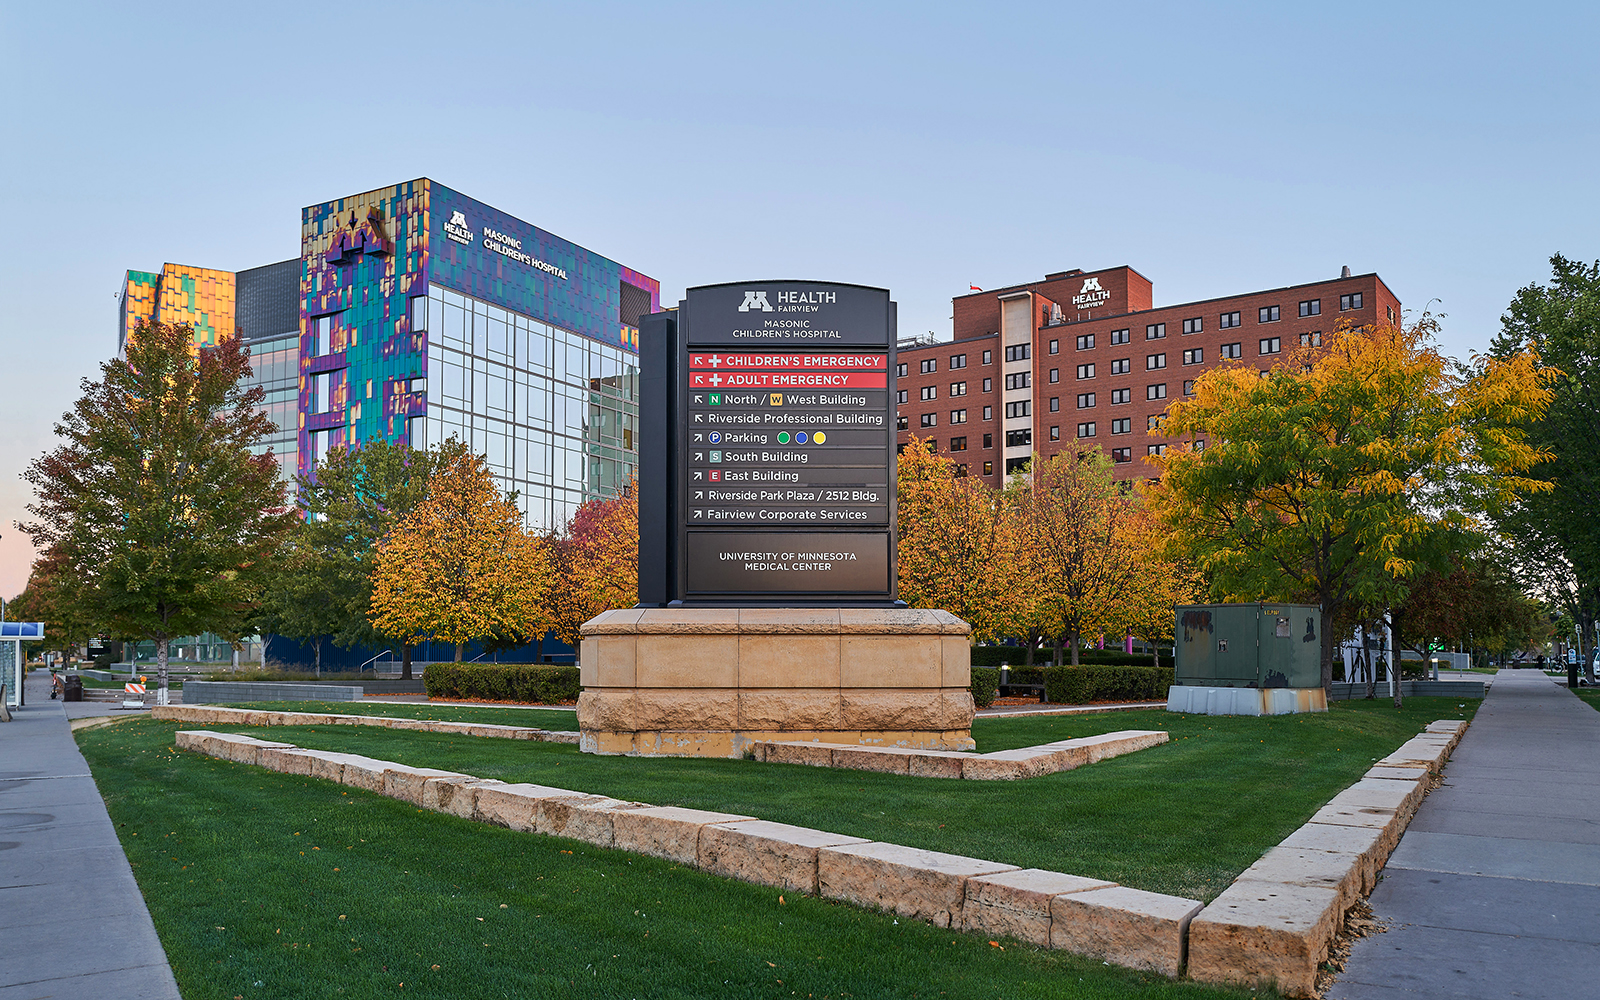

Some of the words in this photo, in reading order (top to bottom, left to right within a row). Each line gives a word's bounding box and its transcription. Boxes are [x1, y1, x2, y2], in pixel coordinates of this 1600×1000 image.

[444, 222, 473, 242] HEALTH
[484, 227, 522, 250] MASONIC
[484, 239, 531, 265] CHILDREN'S
[532, 258, 568, 280] HOSPITAL
[778, 292, 836, 303] HEALTH
[1072, 290, 1110, 304] HEALTH
[764, 320, 810, 328] MASONIC
[732, 330, 790, 338] CHILDREN'S
[794, 330, 842, 338] HOSPITAL
[726, 356, 800, 366] CHILDREN'S
[804, 356, 880, 366] EMERGENCY
[726, 376, 768, 385] ADULT
[772, 376, 848, 385] EMERGENCY
[712, 396, 718, 404] N
[726, 394, 758, 404] North
[760, 394, 768, 406] /
[786, 394, 816, 404] West
[820, 394, 866, 407] Building
[708, 414, 760, 424] Riverside
[764, 414, 832, 426] Professional
[836, 414, 882, 426] Building
[712, 434, 720, 442] P
[726, 432, 768, 444] Parking
[712, 452, 719, 460] S
[726, 452, 758, 462] South
[762, 452, 808, 464] Building
[712, 472, 718, 480] E
[724, 470, 750, 480] East
[752, 470, 798, 482] Building
[708, 490, 758, 500] Riverside
[760, 490, 784, 500] Park
[786, 490, 815, 500] Plaza
[816, 490, 824, 502] /
[826, 491, 850, 500] 2512
[852, 490, 880, 502] Bldg.
[708, 510, 756, 520] Fairview
[758, 510, 816, 522] Corporate
[820, 510, 868, 520] Services
[720, 552, 778, 560] UNIVERSITY
[780, 552, 796, 560] OF
[798, 552, 856, 560] MINNESOTA
[744, 562, 790, 570] MEDICAL
[792, 562, 832, 570] CENTER
